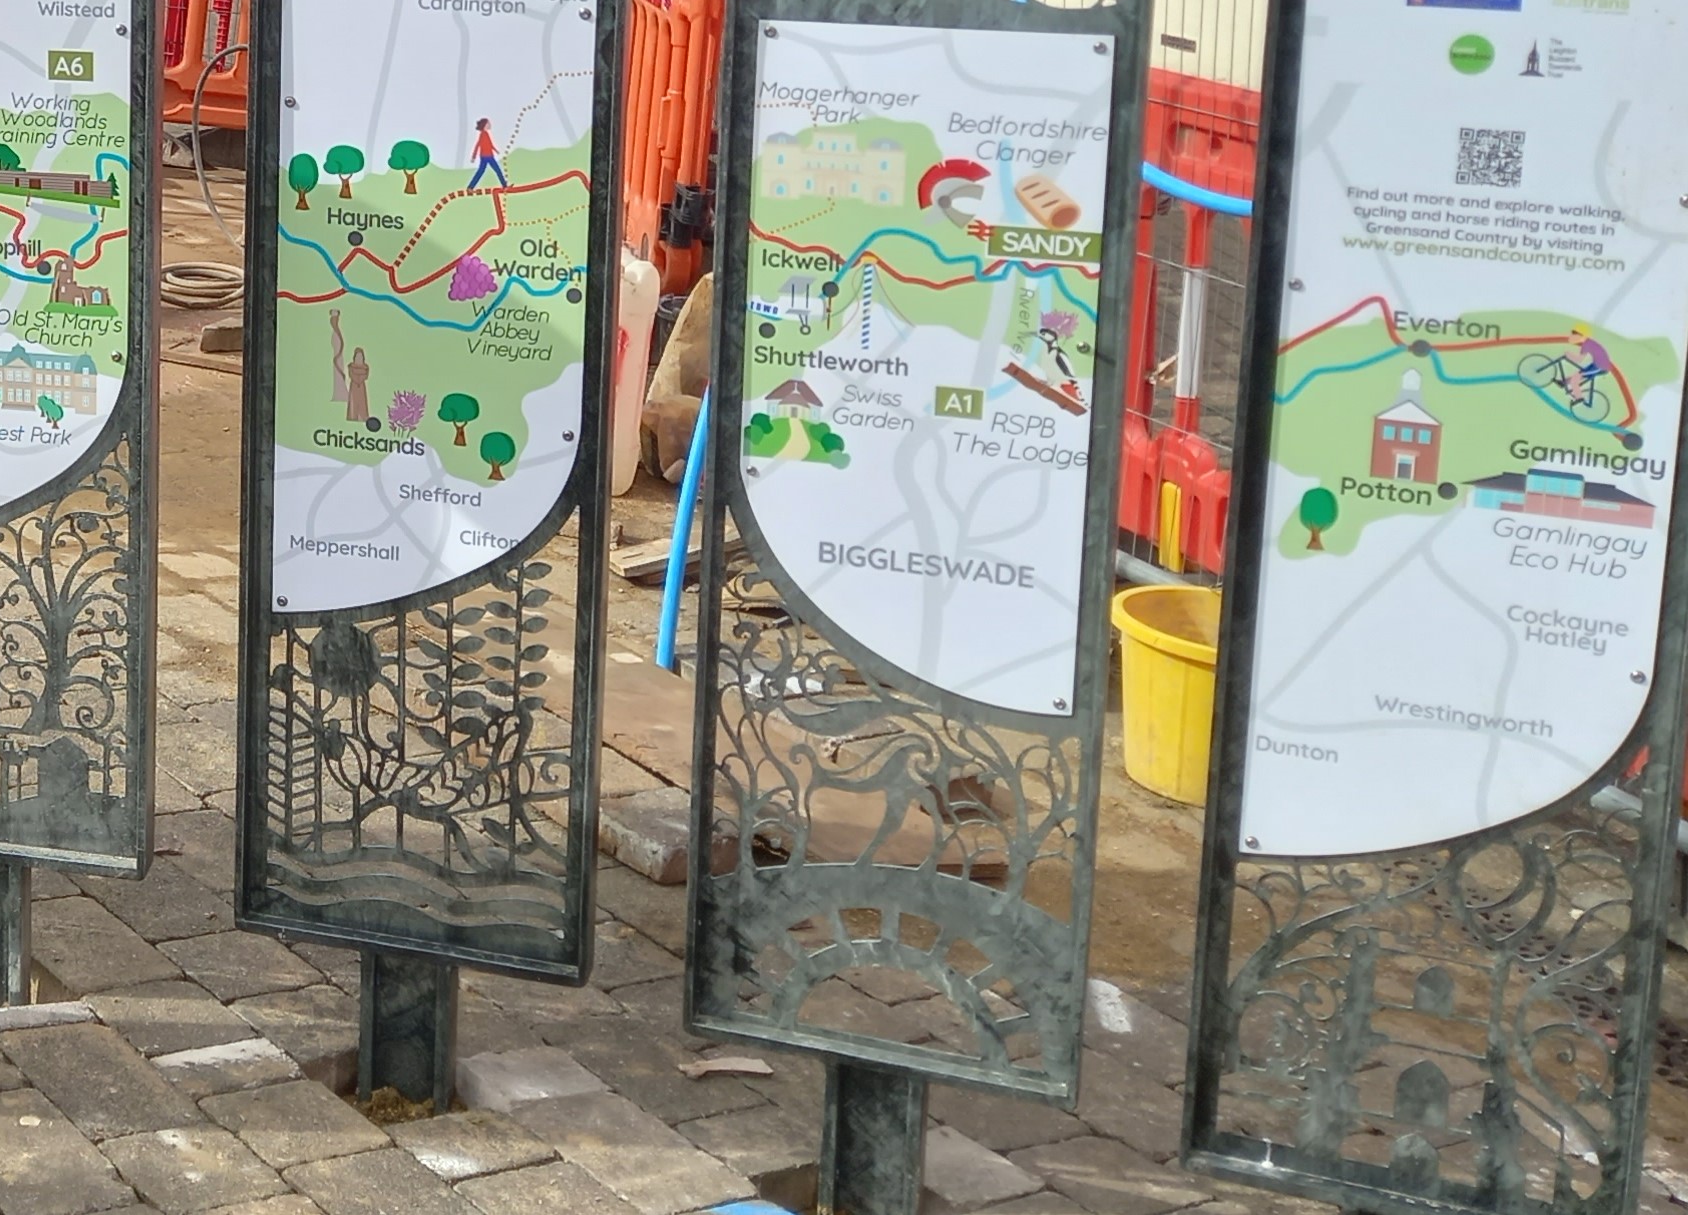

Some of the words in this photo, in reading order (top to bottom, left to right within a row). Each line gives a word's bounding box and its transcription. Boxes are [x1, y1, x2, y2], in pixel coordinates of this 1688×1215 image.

[38, 2, 115, 18] Wilstead
[54, 56, 83, 75] A6
[11, 93, 91, 115] Working
[759, 82, 920, 108] Moggerhanger
[1, 111, 107, 130] Woodlands
[815, 105, 862, 125] Park
[948, 113, 1107, 142] Bedfordshire
[62, 130, 125, 148] Centre
[976, 140, 1076, 169] Clanger
[1347, 186, 1379, 201] Find
[1383, 191, 1408, 202] out
[1413, 193, 1455, 206] more
[1460, 197, 1490, 210] and
[1495, 198, 1554, 215] explore
[327, 208, 404, 231] Haynes
[520, 239, 557, 259] Old
[1002, 232, 1091, 257] SANDY
[1343, 236, 1625, 271] www.greensandcountry.com
[493, 259, 582, 281] Warden
[762, 249, 840, 272] Ickwell
[32, 311, 58, 329] St.
[62, 314, 122, 335] Mary's
[1393, 311, 1501, 340] Everton
[24, 328, 93, 346] Church
[754, 345, 909, 377] Shuttleworth
[842, 385, 902, 407] Swiss
[944, 393, 973, 413] A1
[832, 407, 915, 431] Garden
[990, 412, 1056, 438] RSPB
[30, 428, 72, 445] Park
[313, 429, 425, 456] Chicksands
[953, 431, 1001, 458] The
[1008, 442, 1089, 470] Lodge
[1509, 440, 1666, 481] Gamlingay
[399, 485, 482, 507] Shefford
[1340, 477, 1432, 506] Potton
[290, 535, 400, 562] Meppershall
[1492, 517, 1648, 560] Gamlingay
[818, 541, 1035, 588] BIGGLESWADE
[1509, 546, 1559, 570] Eco
[1567, 555, 1627, 579] Hub
[1506, 604, 1629, 637] Cockayne
[1525, 627, 1607, 656] Hatley
[1374, 695, 1553, 738] Wrestingworth
[1255, 735, 1339, 764] Dunton
